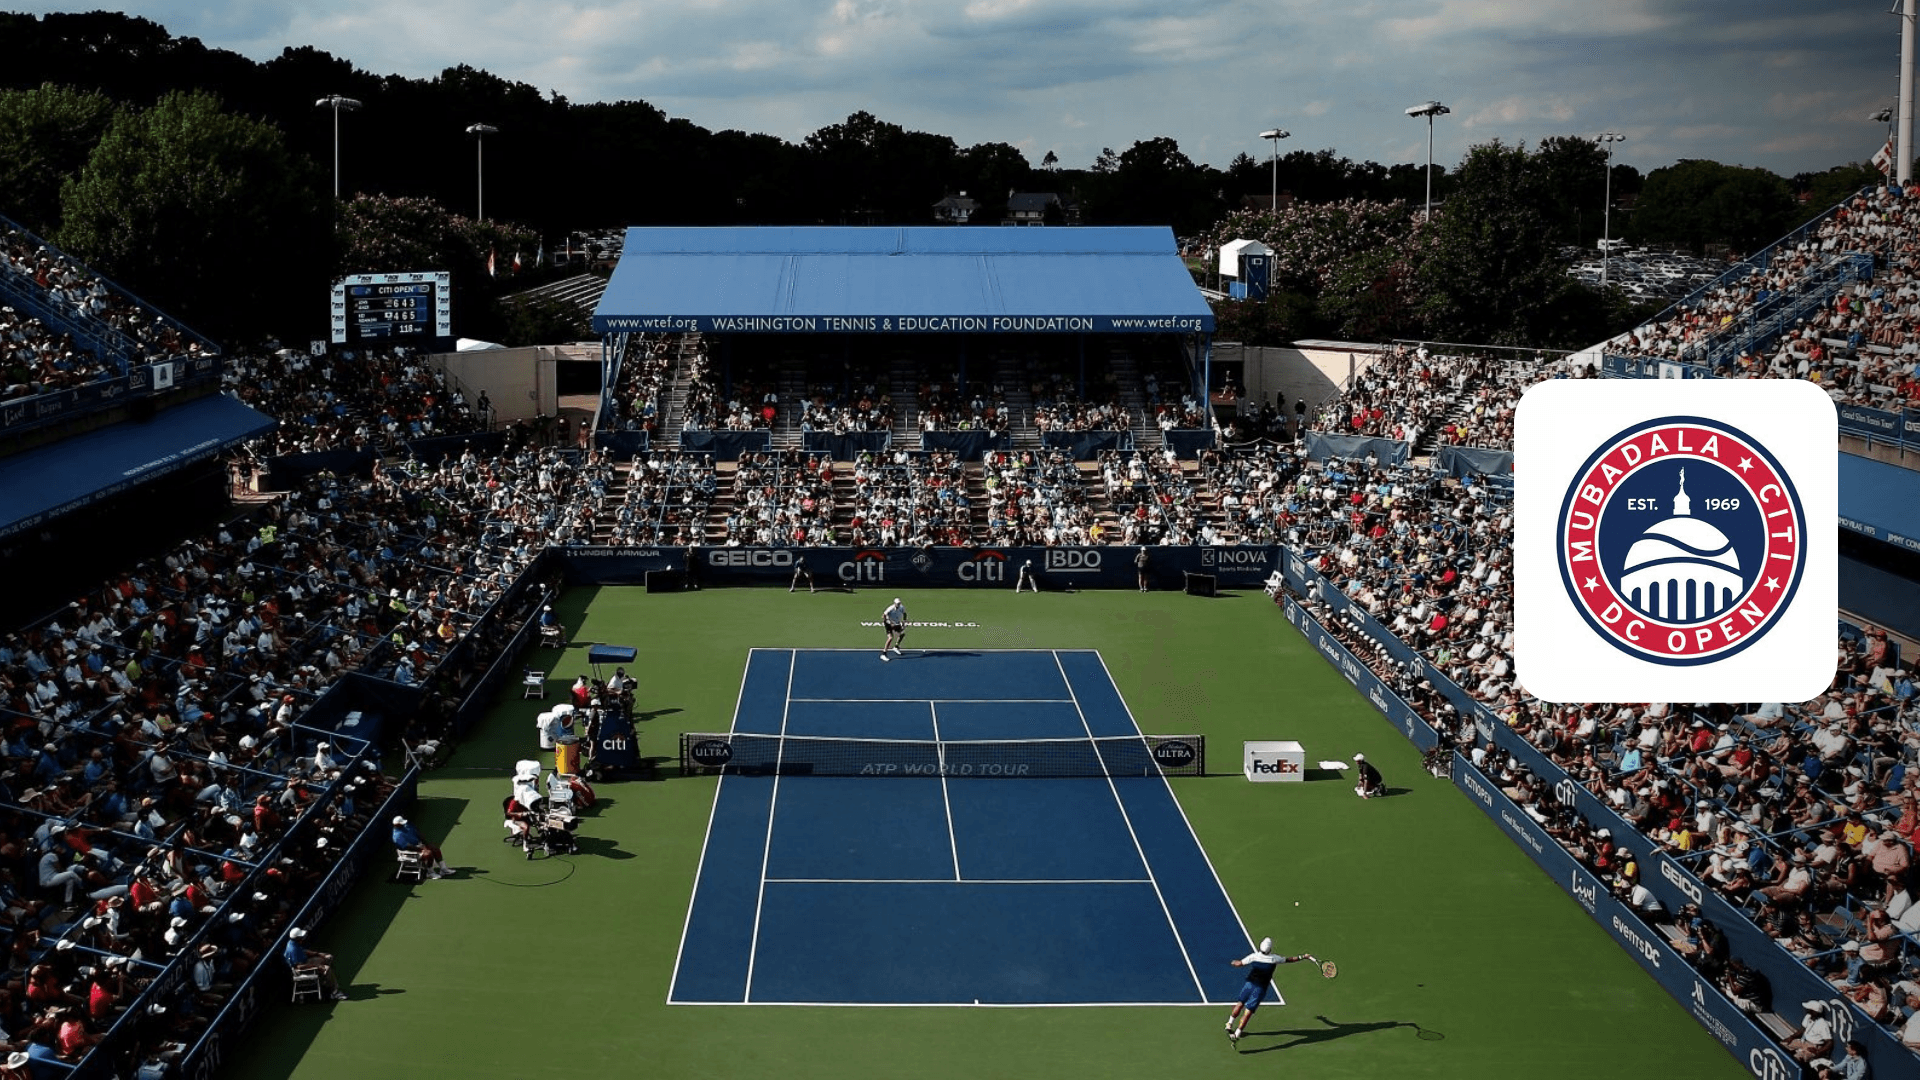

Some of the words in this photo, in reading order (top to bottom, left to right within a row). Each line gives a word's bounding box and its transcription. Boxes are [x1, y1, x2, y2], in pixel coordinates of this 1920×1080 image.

[378, 286, 392, 294] CITI
[606, 316, 698, 331] www.wtef.org
[712, 318, 816, 331] WASHINGTON
[823, 318, 876, 330] TENNIS
[882, 318, 892, 330] &
[899, 318, 988, 330] EDUCATION
[992, 318, 1093, 330] FOUNDATION
[1112, 316, 1202, 331] www.wtef.org
[709, 551, 792, 566] GEICO
[1052, 550, 1101, 568] BDO
[1218, 550, 1267, 563] INOVA
[838, 556, 884, 581] citi
[957, 556, 1004, 581] citi
[602, 738, 626, 750] citi
[696, 748, 729, 756] ULTRA
[1158, 750, 1191, 758] ULTRA
[860, 764, 898, 774] ATP
[904, 764, 973, 774] WORLD
[980, 764, 1029, 775] TOUR
[1254, 759, 1298, 774] FedEx
[1556, 778, 1576, 806] citi
[1572, 870, 1596, 905] Live!
[1661, 860, 1702, 904] GEICO
[1750, 1048, 1787, 1080] citi
